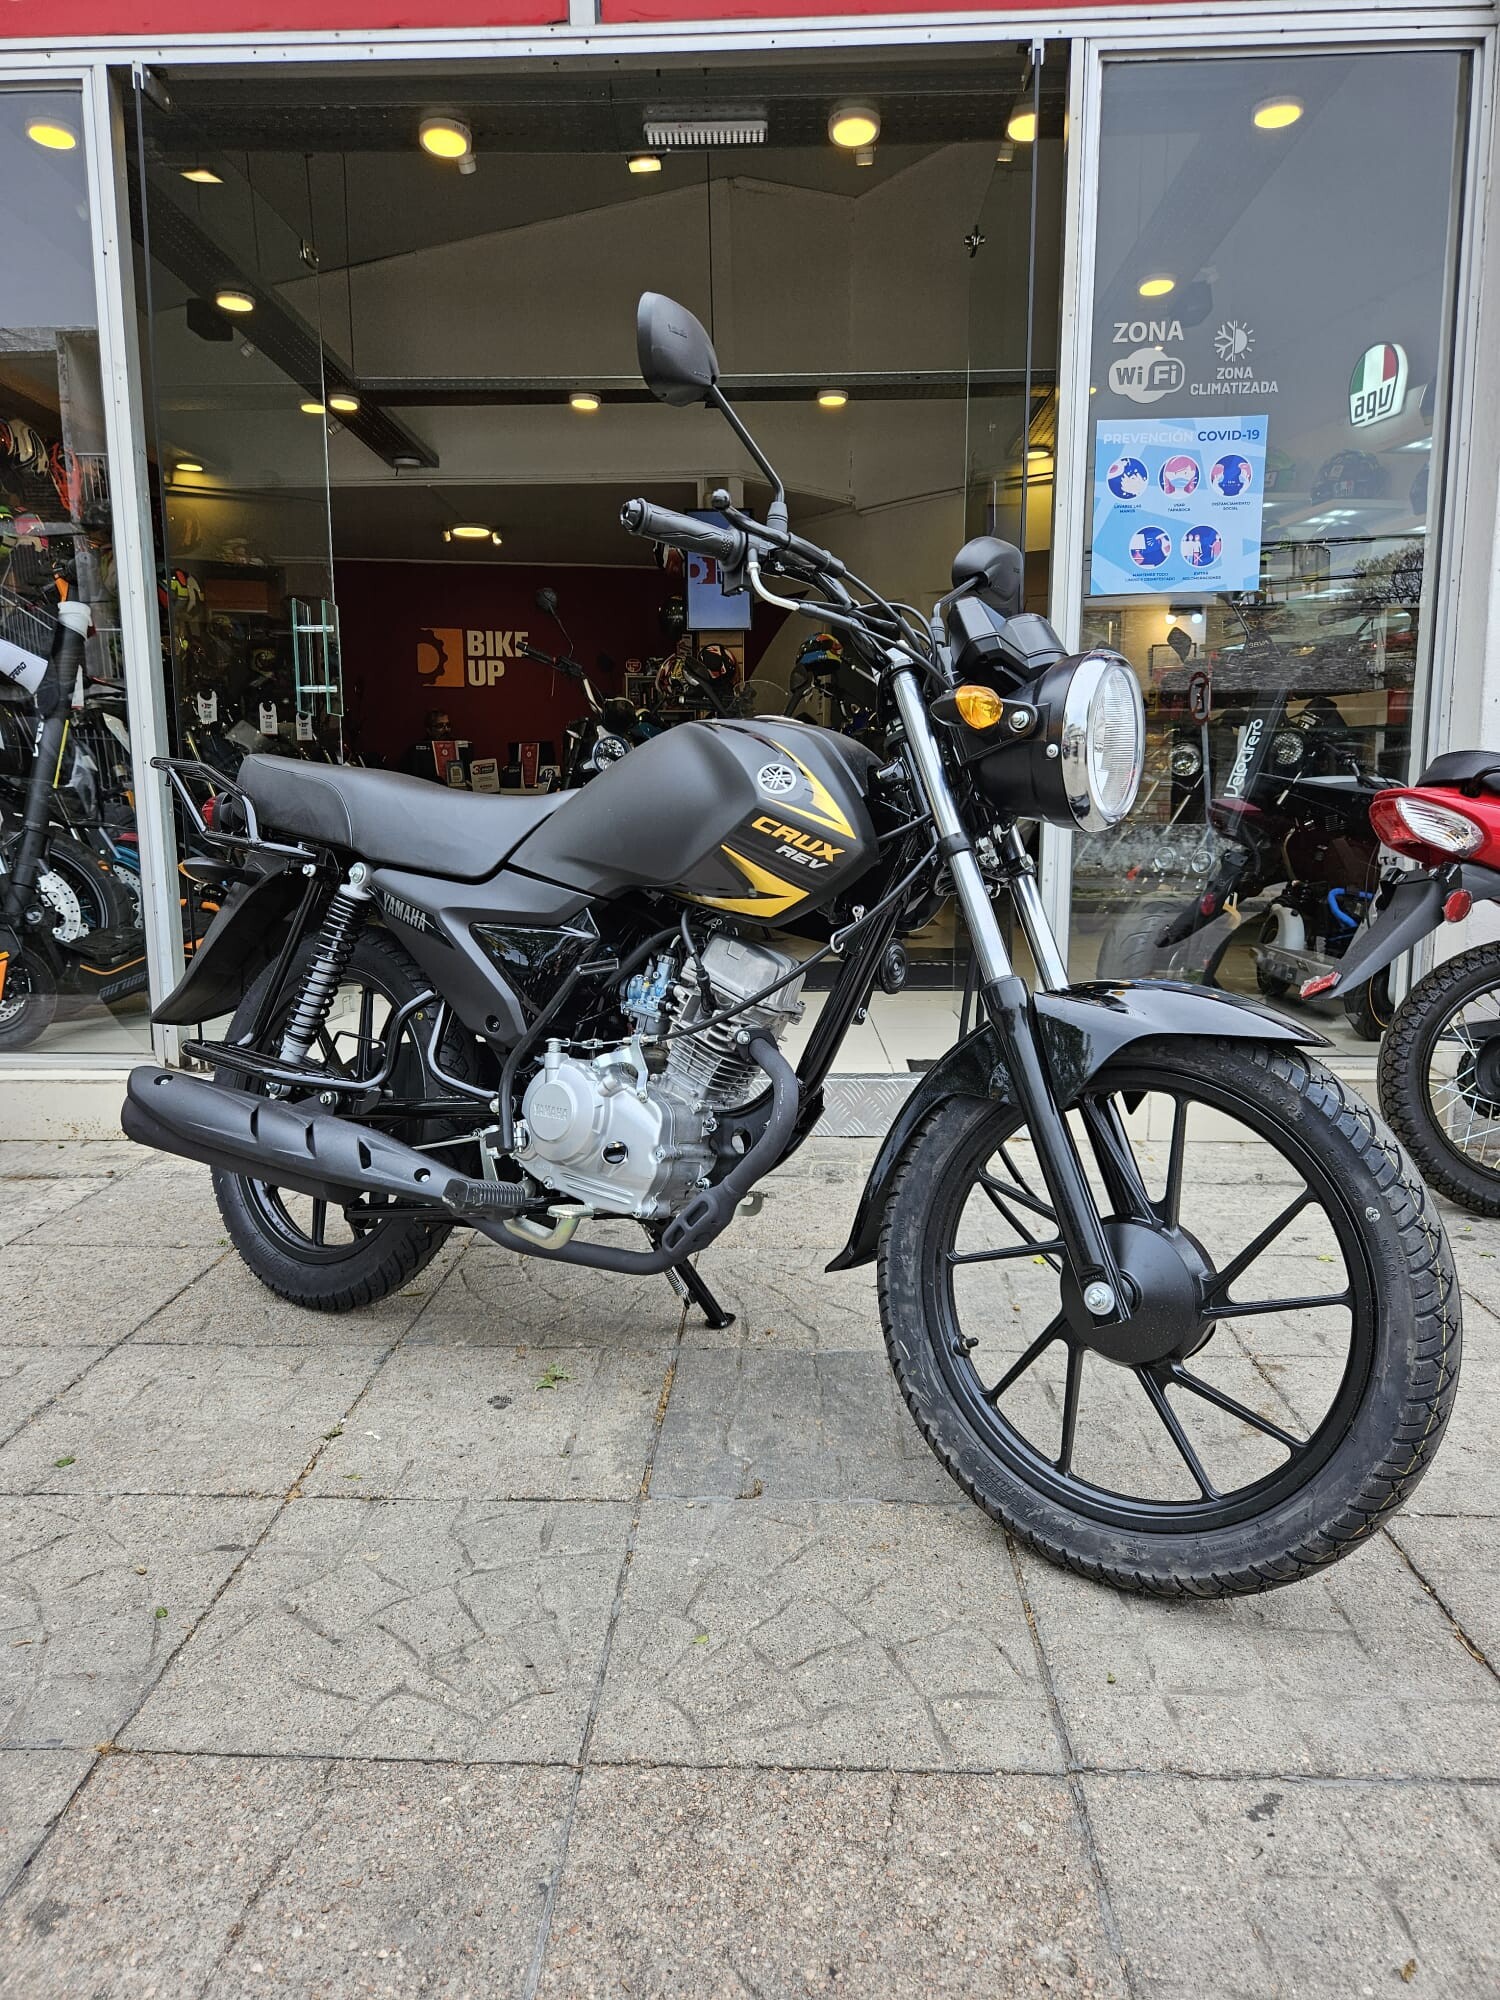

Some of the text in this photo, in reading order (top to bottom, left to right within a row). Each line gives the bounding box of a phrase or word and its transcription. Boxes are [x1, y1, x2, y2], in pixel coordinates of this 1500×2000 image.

[1112, 320, 1184, 343] ZONA
[1216, 367, 1253, 380] ZONA
[1190, 381, 1279, 395] CLIMATIZADA
[1103, 429, 1260, 444] PREVENCIÓN COVID-19
[466, 629, 529, 658] BIKE
[468, 660, 505, 687] UP
[751, 816, 846, 863] CRUX
[775, 844, 829, 869] REV
[383, 892, 426, 932] YAMAHA
[533, 1103, 568, 1120] YAMAHA
